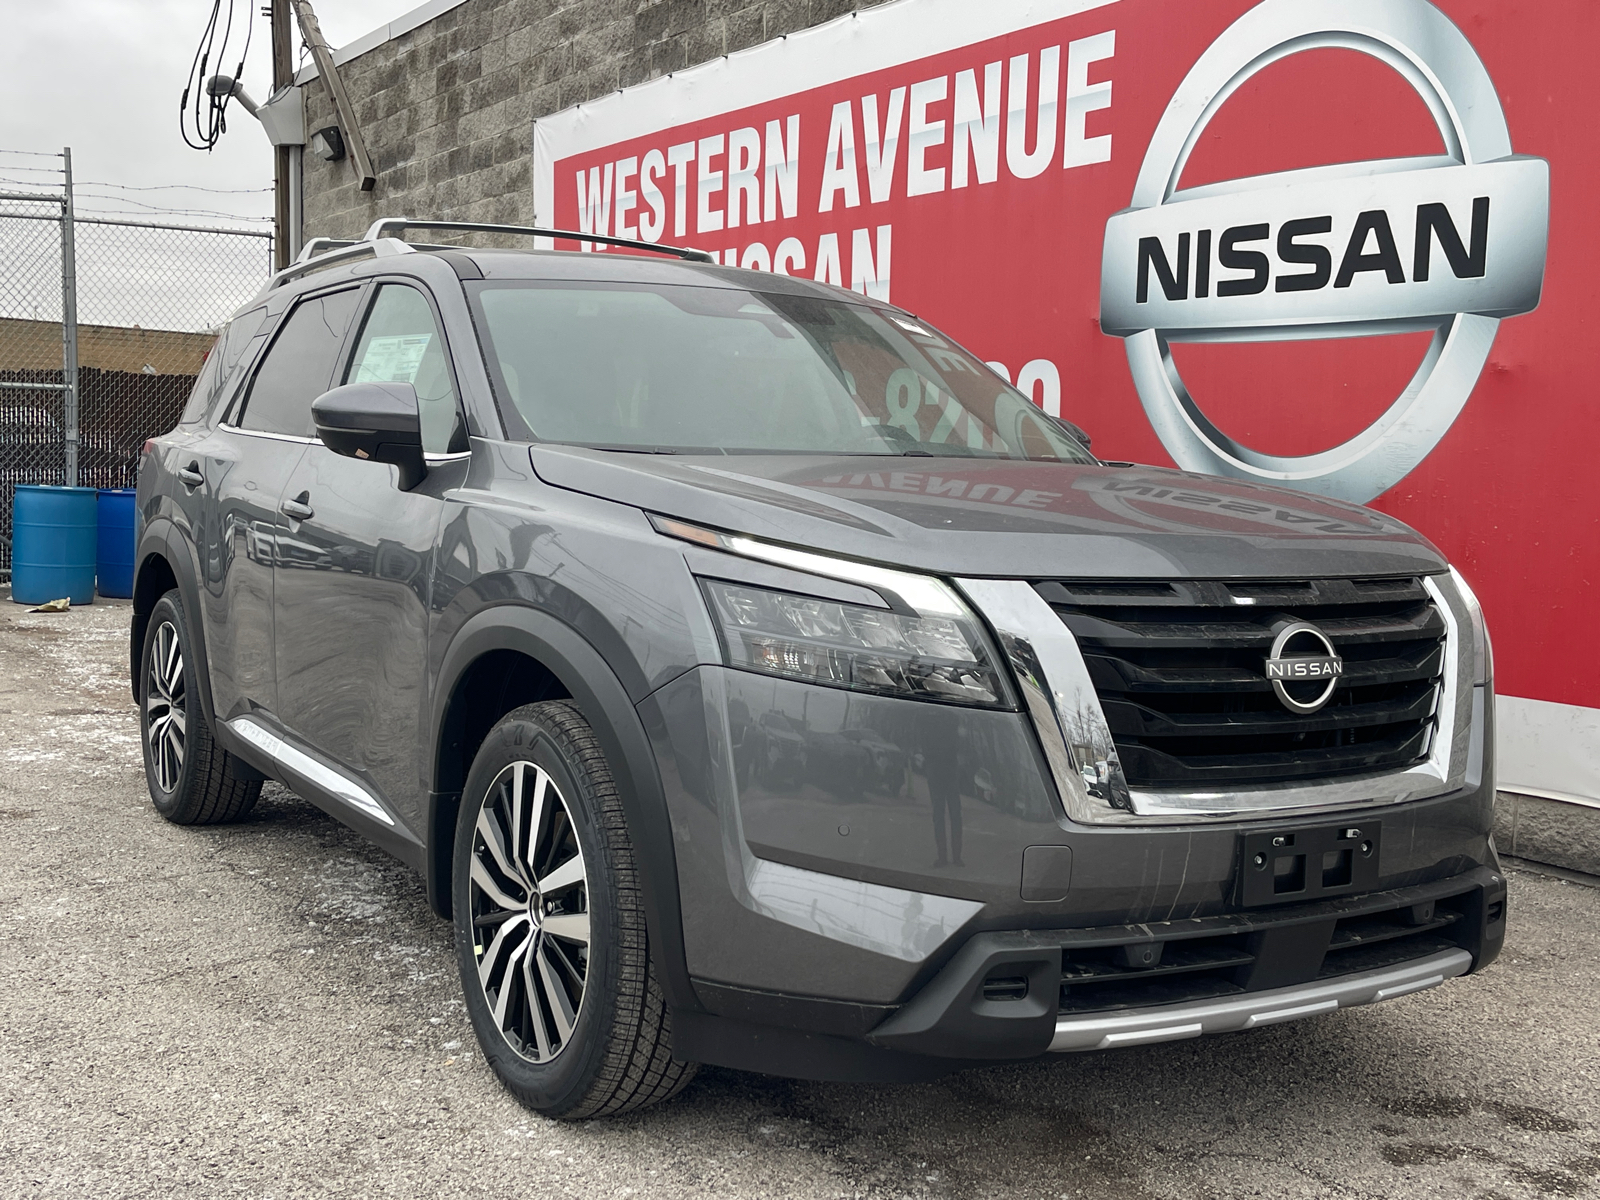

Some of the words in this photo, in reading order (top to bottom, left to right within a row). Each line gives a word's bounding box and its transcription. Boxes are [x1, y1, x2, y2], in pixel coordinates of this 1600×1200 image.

[576, 114, 800, 252] WESTERN
[819, 29, 1116, 213] AVENUE
[711, 223, 893, 305] SAN
[1136, 196, 1490, 304] NISSAN
[1268, 660, 1342, 677] NISSAN
